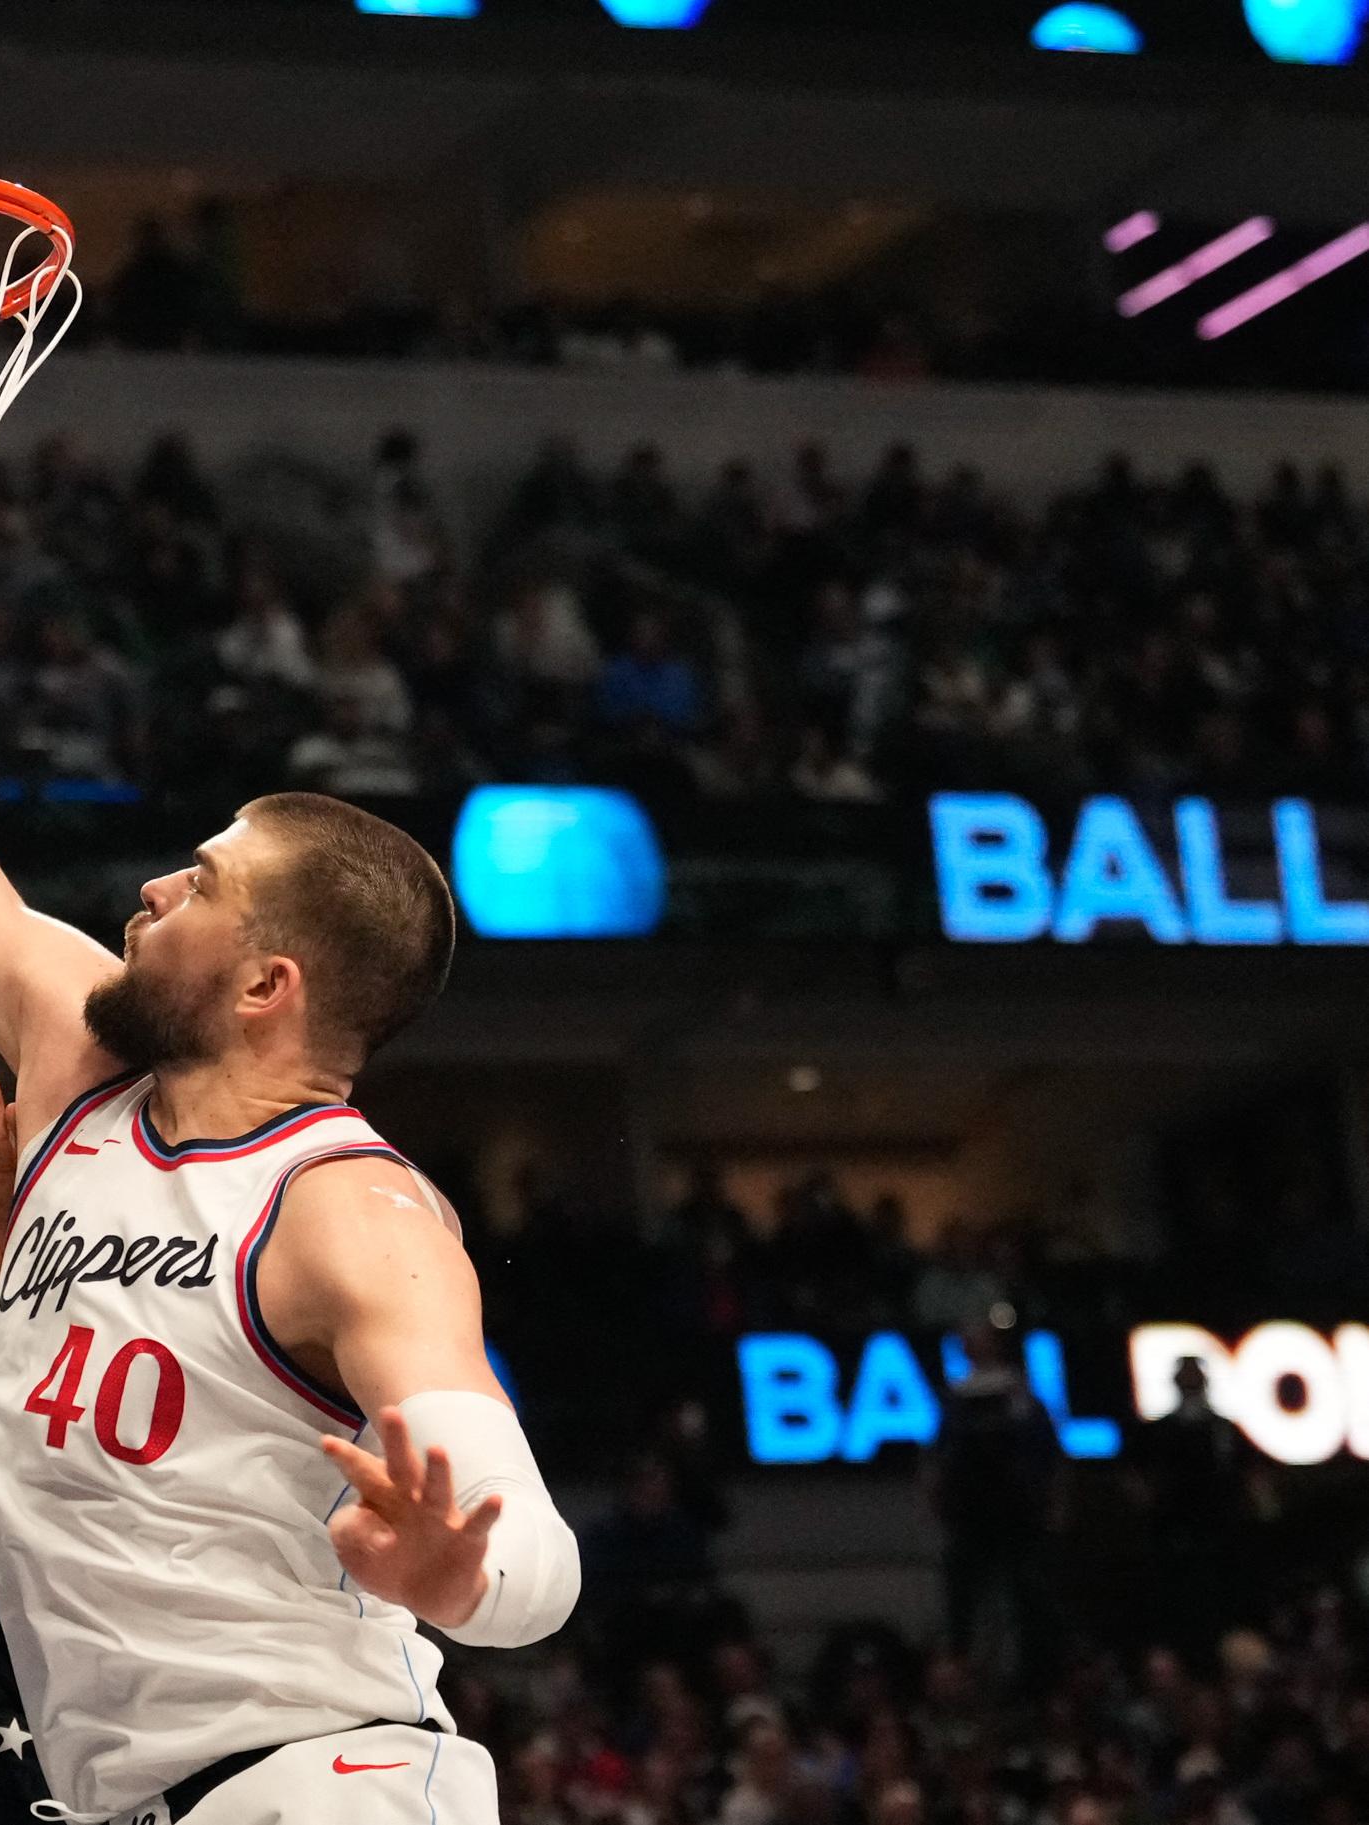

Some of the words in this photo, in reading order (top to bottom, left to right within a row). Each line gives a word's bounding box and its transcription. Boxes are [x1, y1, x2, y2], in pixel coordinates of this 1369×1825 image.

[930, 791, 1369, 945] BALL
[0, 1210, 219, 1319] Clippers
[25, 1325, 185, 1465] 40
[735, 1331, 1122, 1464] BAL
